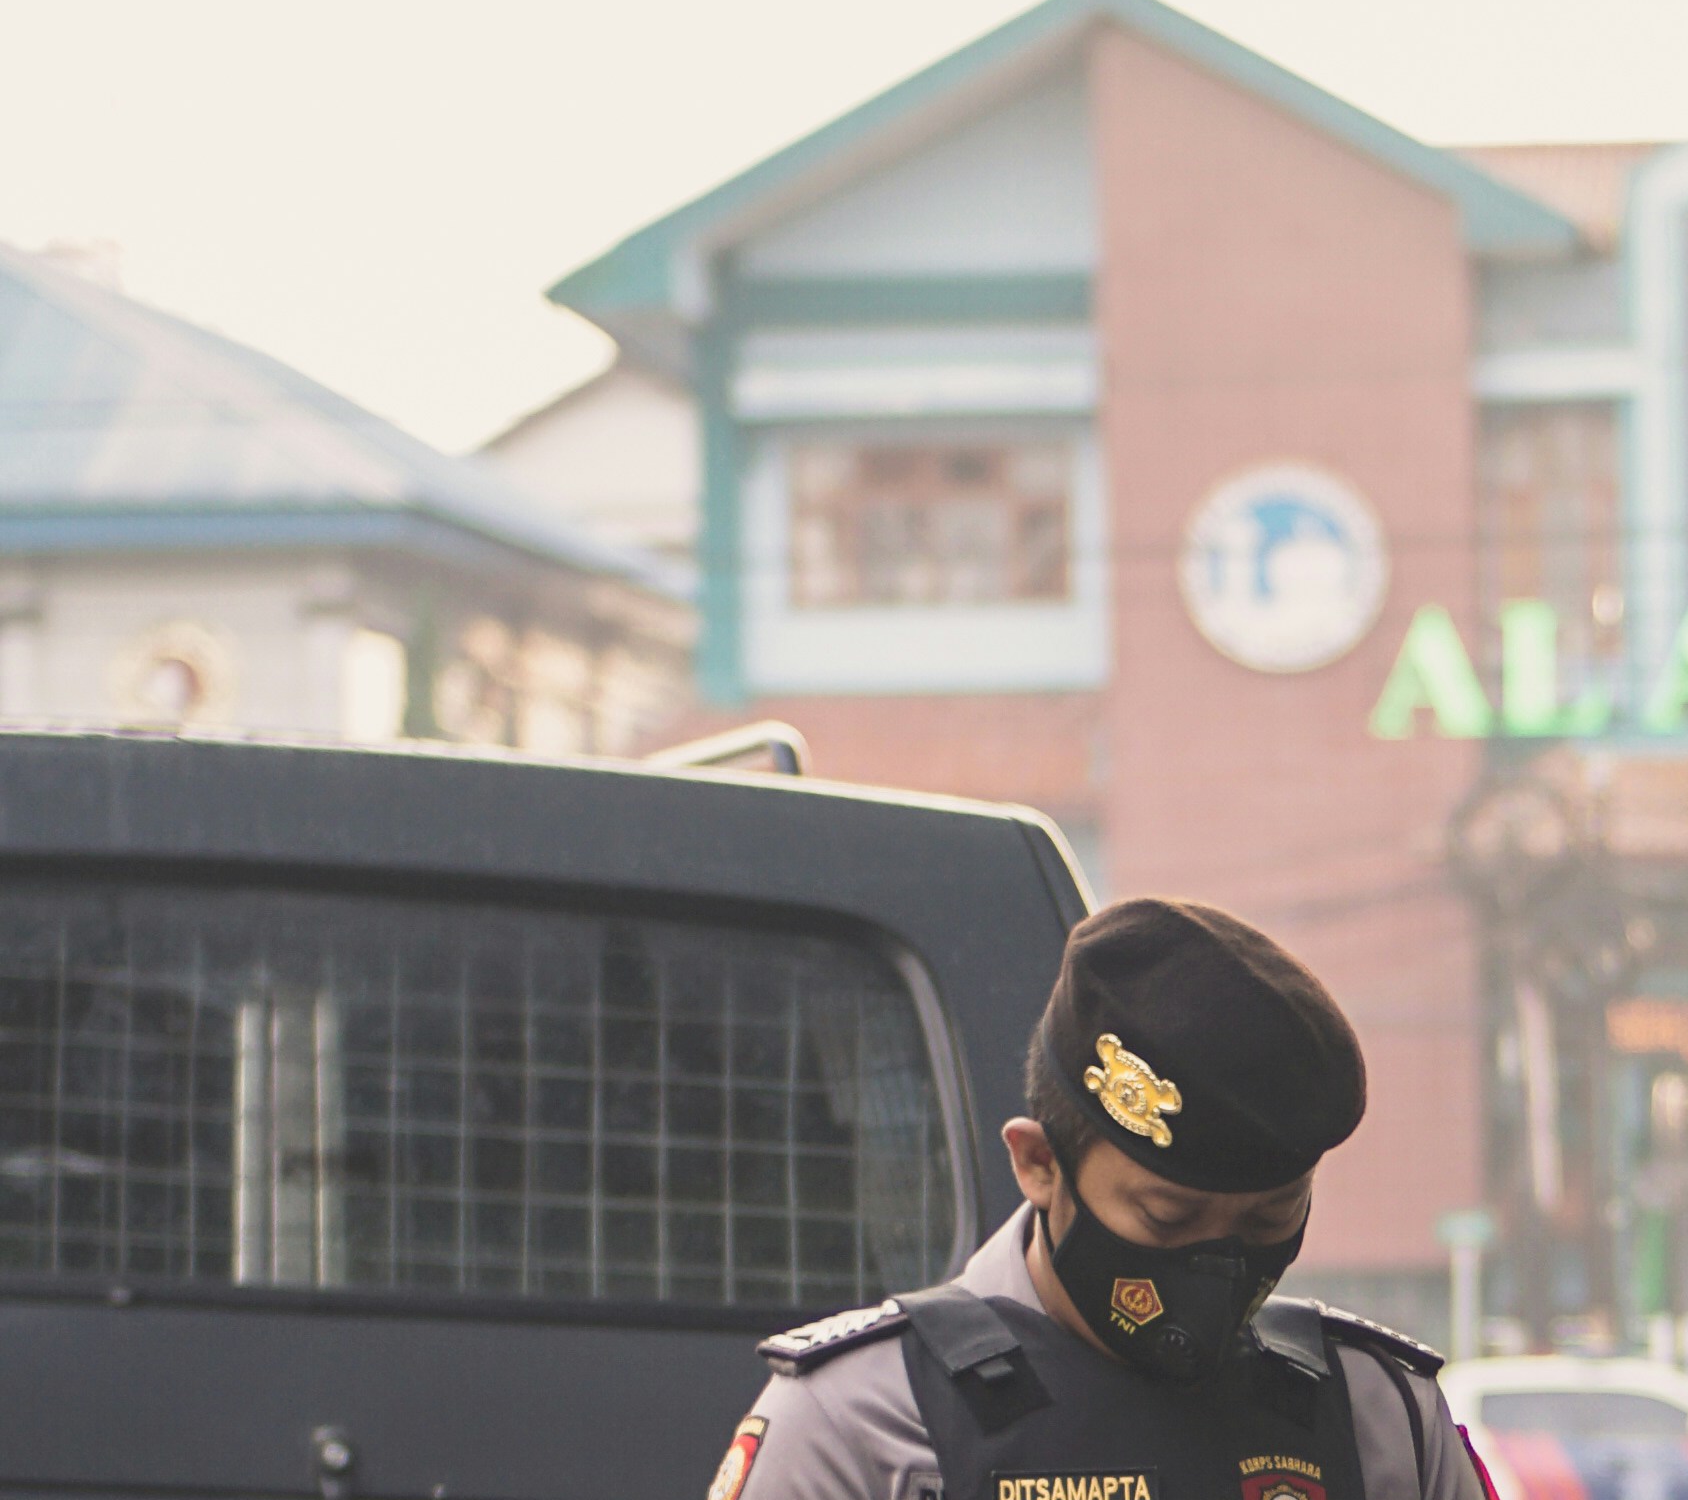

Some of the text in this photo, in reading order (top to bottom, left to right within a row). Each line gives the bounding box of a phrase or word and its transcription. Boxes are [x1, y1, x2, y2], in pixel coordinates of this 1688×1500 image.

[1374, 602, 1608, 738] AL
[1110, 1311, 1136, 1335] TNI
[1274, 1455, 1321, 1480] SABHARA
